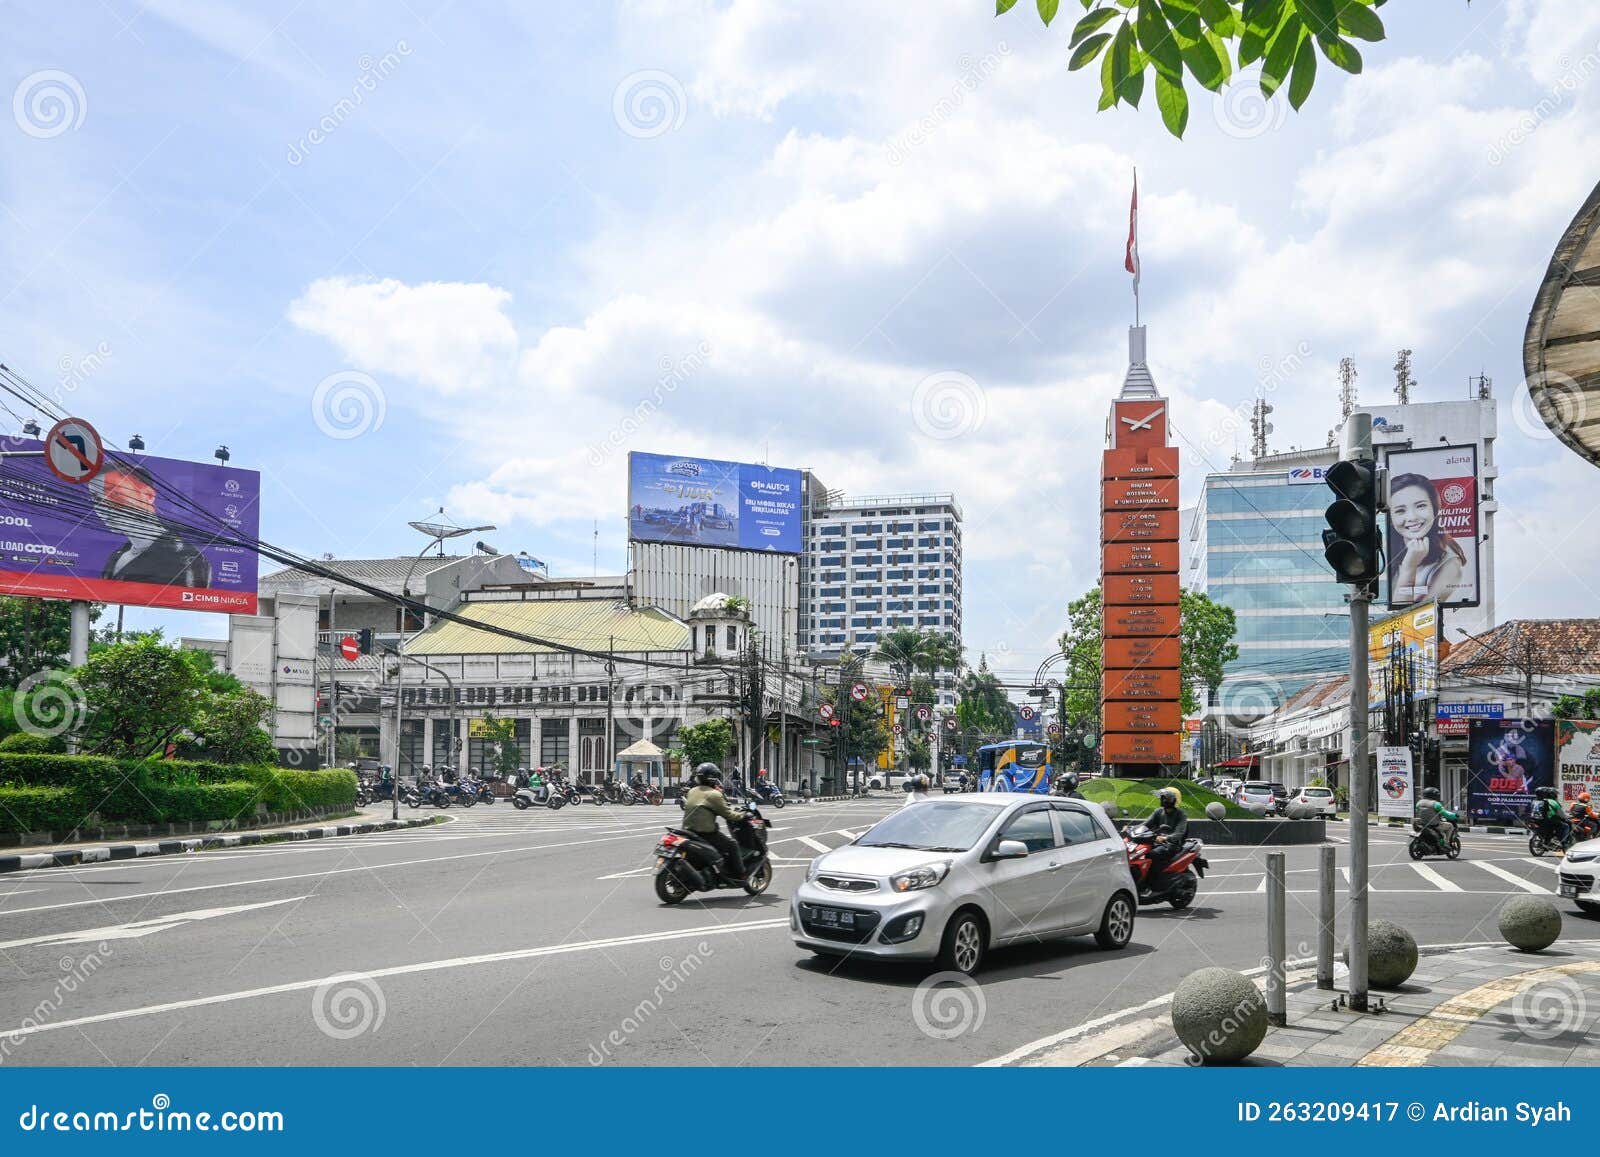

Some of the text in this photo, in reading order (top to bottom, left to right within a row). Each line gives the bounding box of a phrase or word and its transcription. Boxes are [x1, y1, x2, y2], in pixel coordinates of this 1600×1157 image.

[1446, 456, 1471, 465] alana
[766, 482, 790, 492] AUTOS
[1437, 507, 1471, 516] KULITMU
[1438, 515, 1471, 528] UNIK
[24, 543, 56, 555] OCTO
[195, 594, 248, 606] CIMB NIAGA
[1437, 704, 1503, 714] POLISI MILITER
[1561, 763, 1593, 775] BATIK
